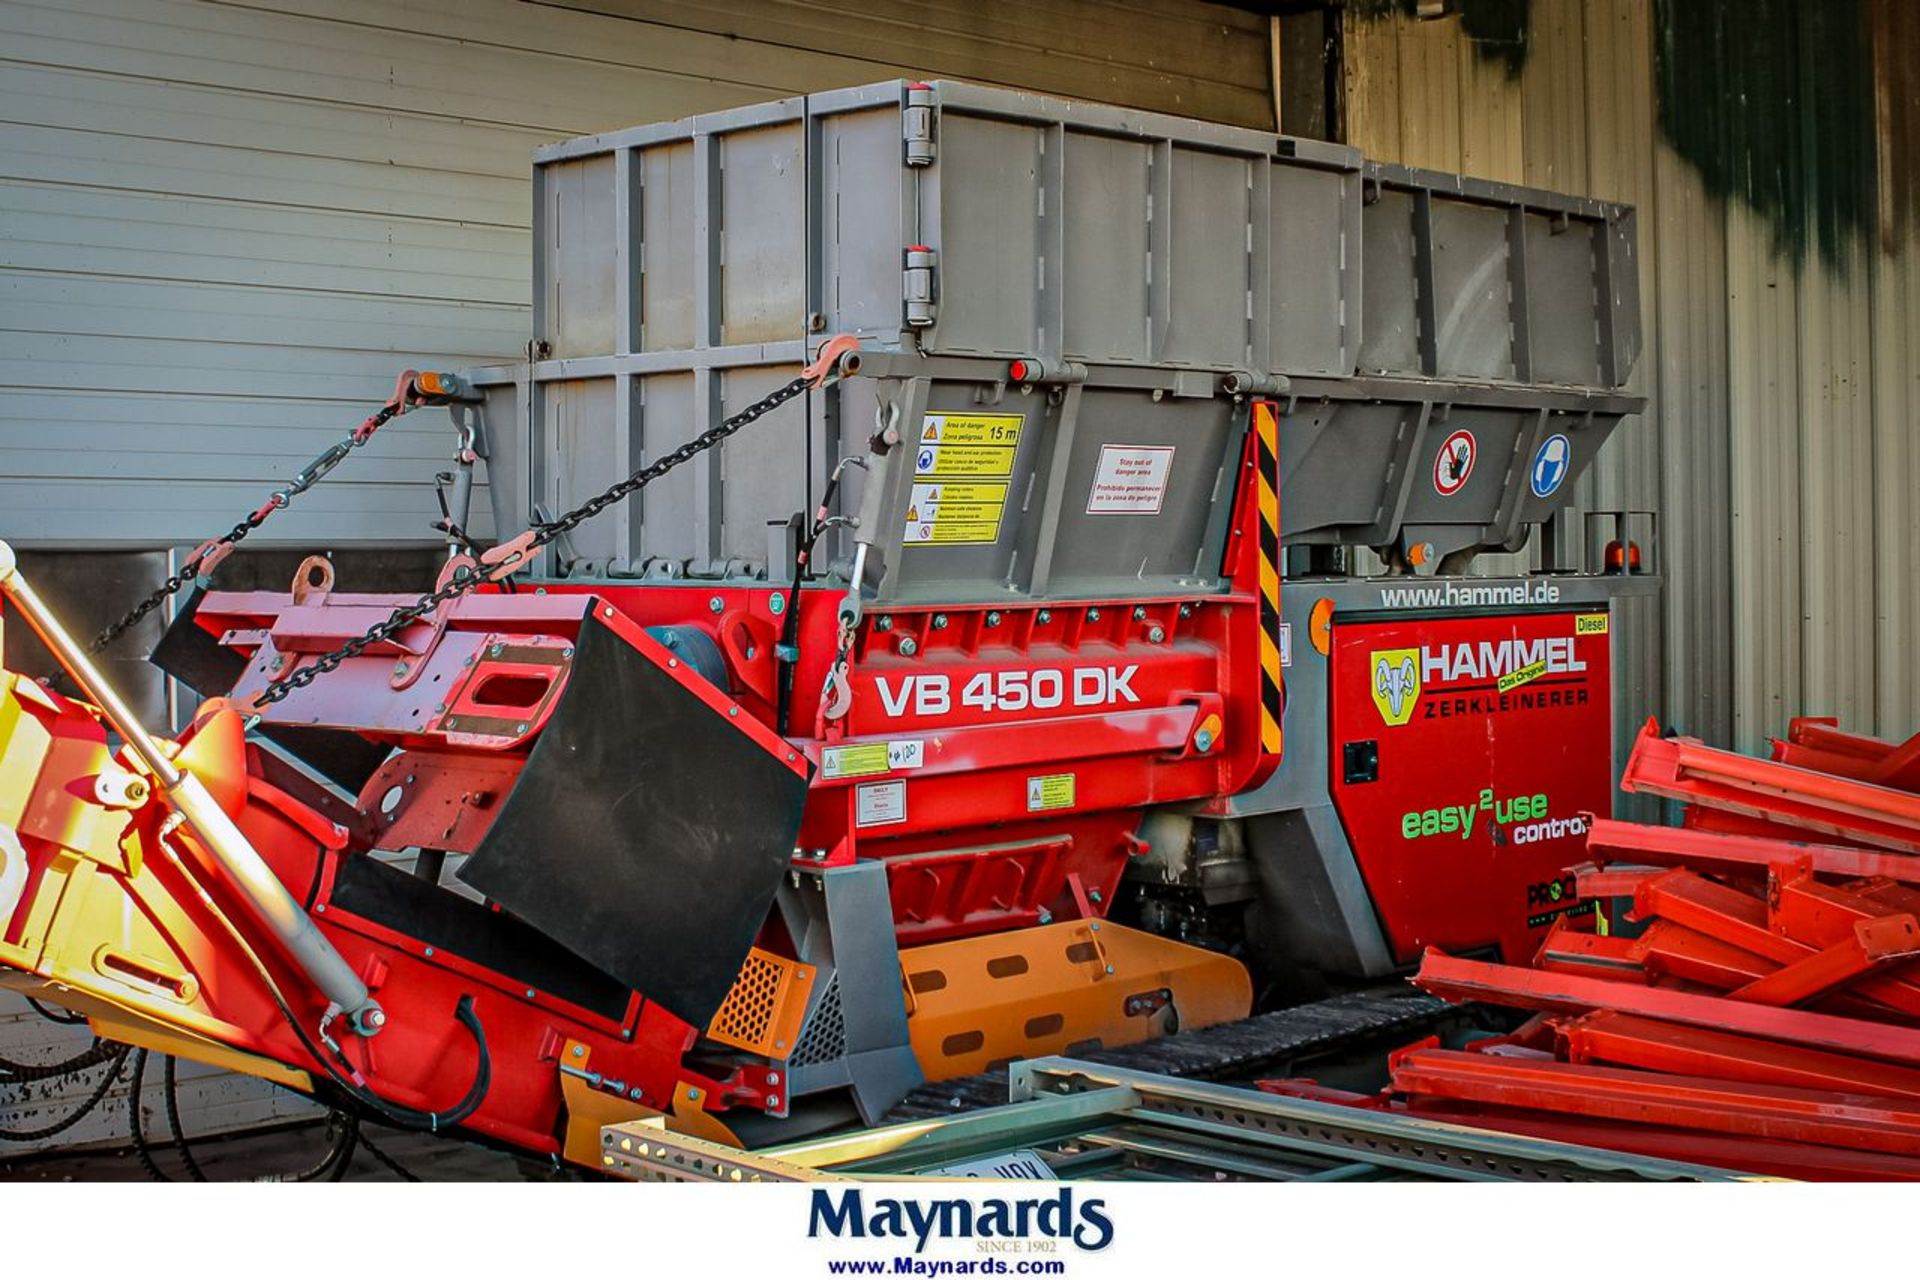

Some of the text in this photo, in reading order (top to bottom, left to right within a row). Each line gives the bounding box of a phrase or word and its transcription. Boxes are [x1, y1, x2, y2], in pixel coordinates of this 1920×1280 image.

[990, 426, 1017, 440] 15 m
[1119, 458, 1133, 466] Stay
[1381, 581, 1560, 607] www.hammel.de
[1578, 617, 1606, 632] Diesel
[1422, 637, 1586, 683] HAMMEL
[875, 665, 1140, 717] VB 450 DK
[1500, 676, 1516, 690] Das
[1424, 690, 1589, 719] ZERKLEINERER
